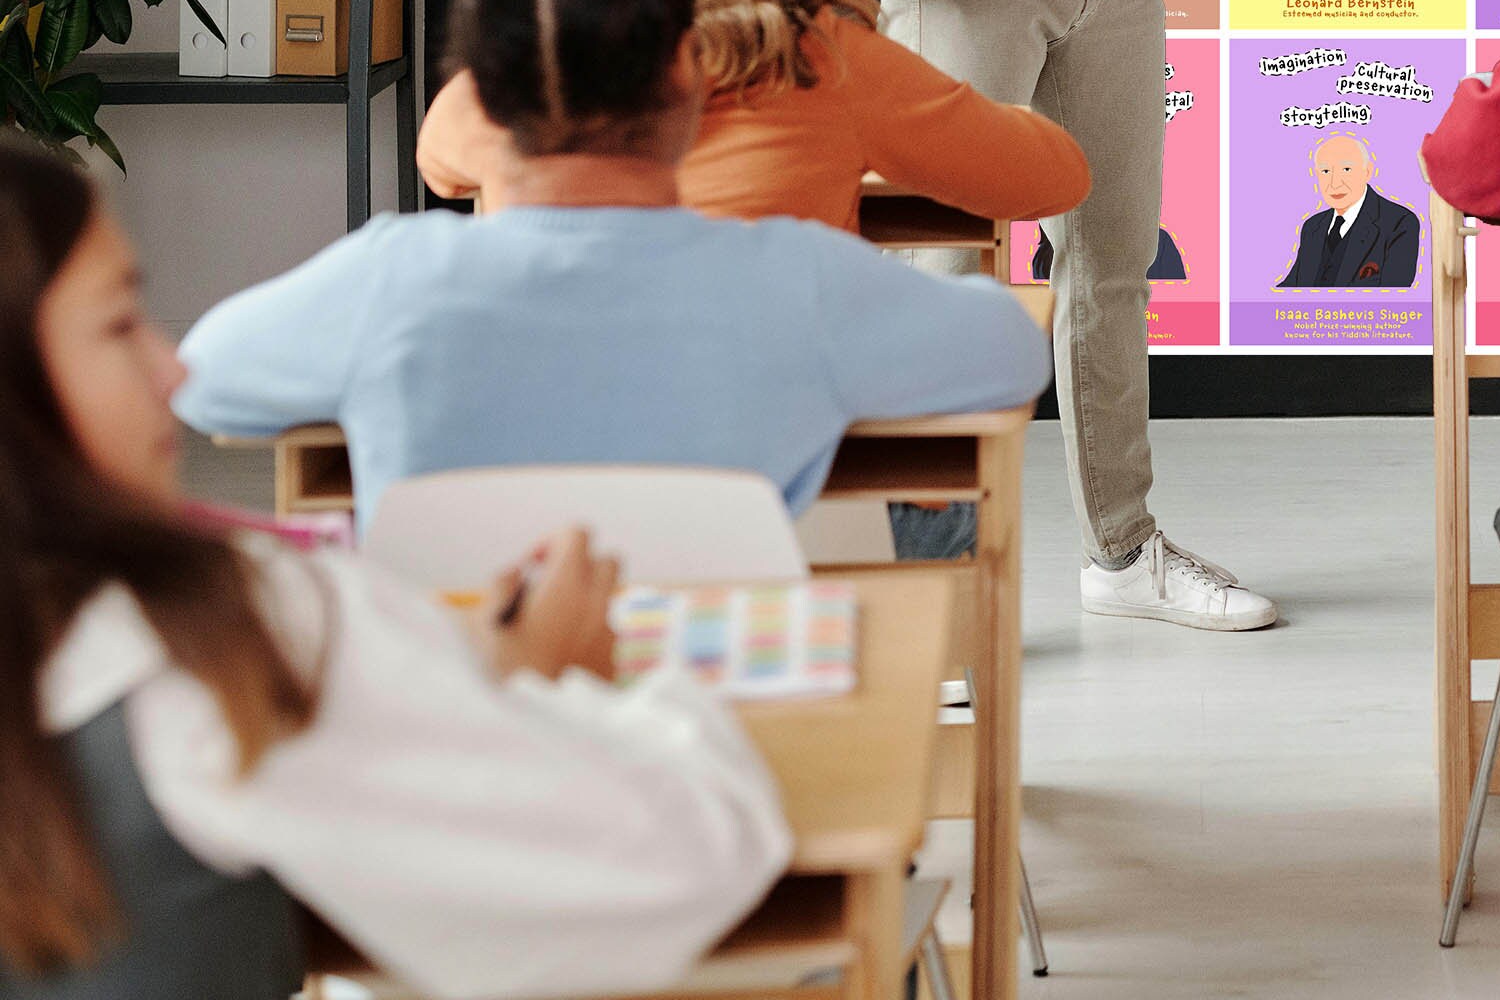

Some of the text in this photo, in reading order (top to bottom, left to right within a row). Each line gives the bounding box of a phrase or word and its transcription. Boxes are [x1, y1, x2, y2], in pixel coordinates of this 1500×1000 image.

[1283, 10, 1322, 18] Esteemed
[1262, 52, 1343, 72] Imagination
[1358, 65, 1411, 81] Cultural
[1340, 79, 1430, 99] preservation
[1284, 106, 1368, 124] storytelling
[1275, 309, 1423, 324] Isaac Bashevis Singer
